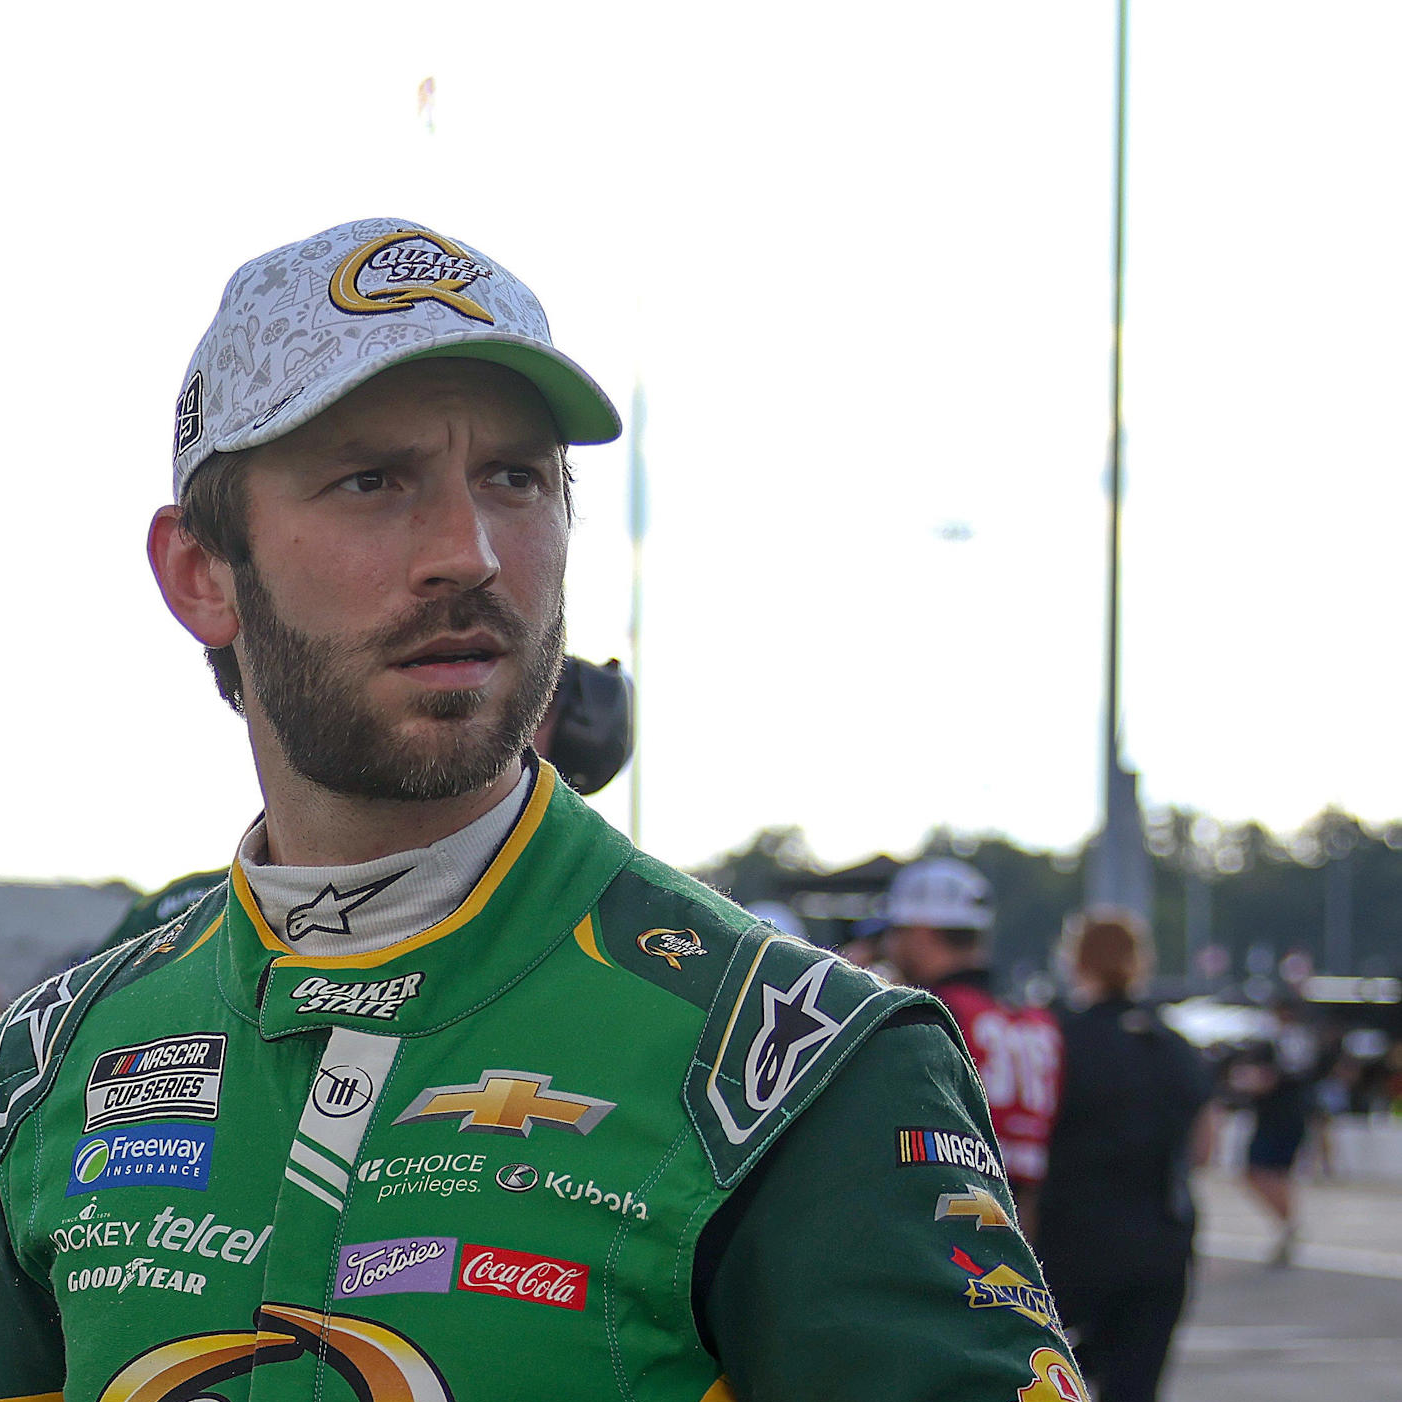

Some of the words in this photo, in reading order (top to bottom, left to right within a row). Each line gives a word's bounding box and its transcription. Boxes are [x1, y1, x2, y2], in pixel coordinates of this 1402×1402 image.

[371, 247, 491, 278] QUAKER
[387, 263, 477, 282] STATE
[659, 942, 695, 957] STATE
[660, 934, 708, 956] QUAKER
[291, 972, 423, 1001] QUAKER
[298, 995, 404, 1018] STATE
[136, 1042, 210, 1073] NASCAR
[104, 1083, 143, 1110] CUP
[140, 1077, 205, 1101] SERIES
[109, 1136, 206, 1165] Freeway
[105, 1163, 201, 1178] INSURANCE
[385, 1154, 487, 1178] CHOICE
[543, 1171, 648, 1221] Kubota
[146, 1206, 274, 1265] telcel
[67, 1262, 207, 1296] GOODYEAR
[341, 1240, 445, 1294] Tootsies
[462, 1252, 585, 1304] Coca-Cola
